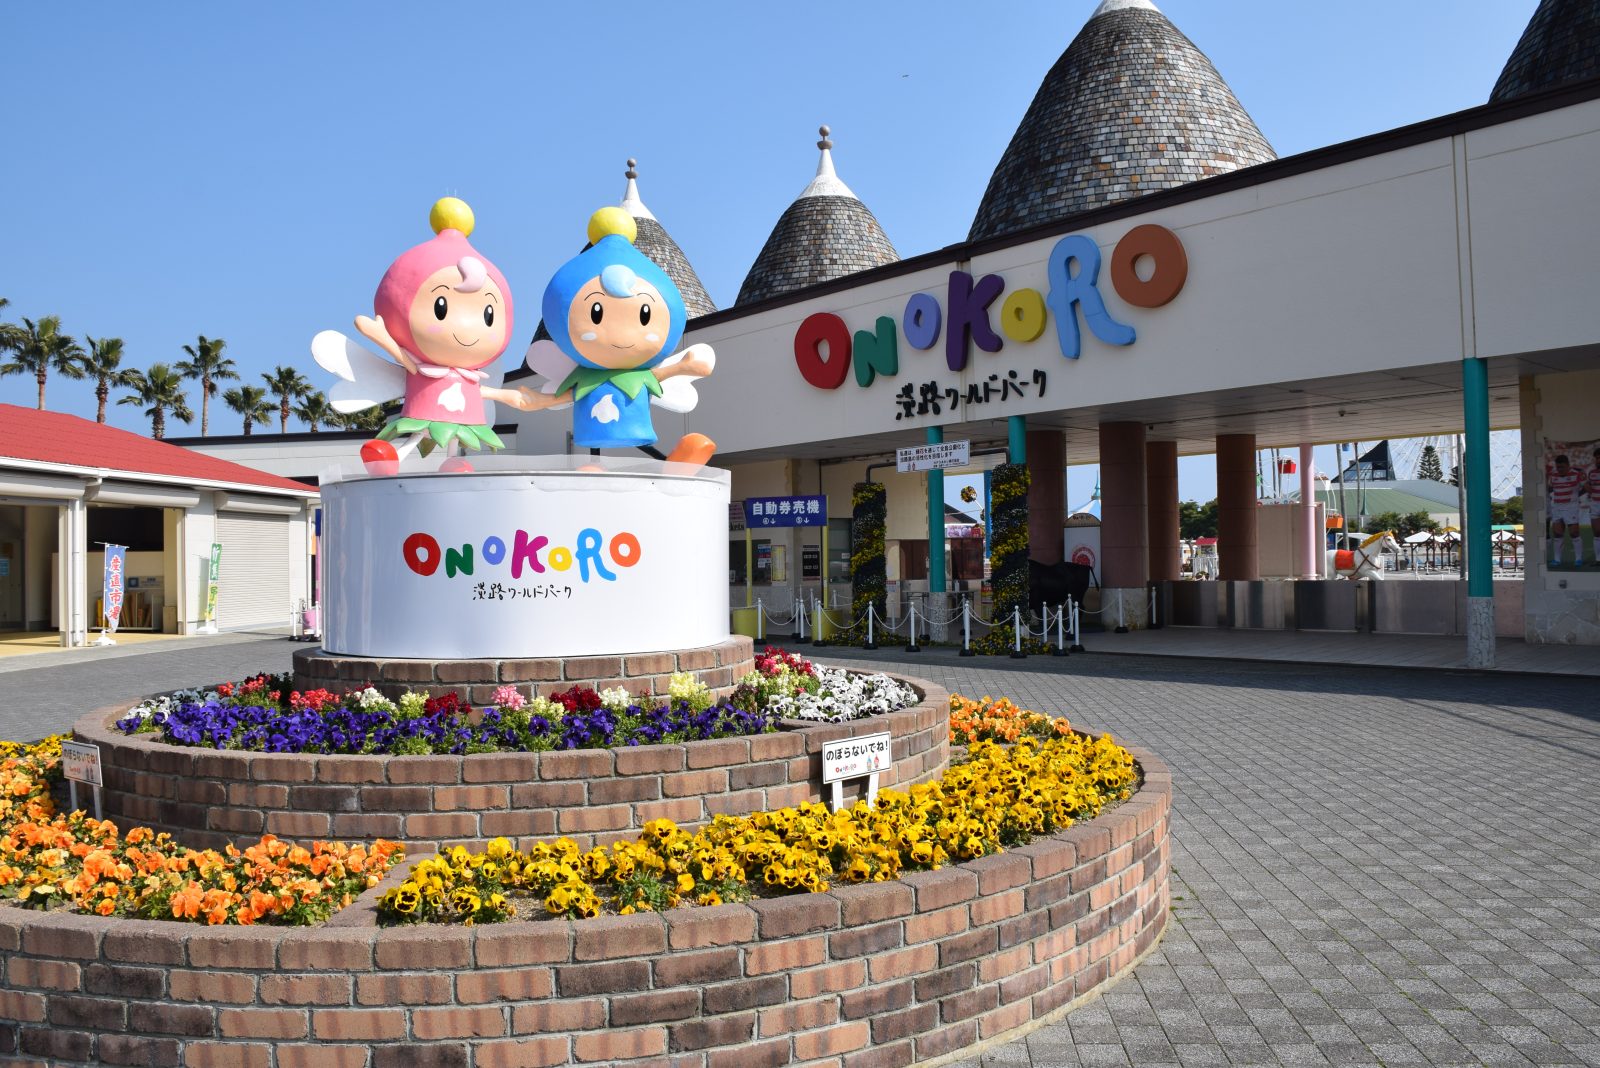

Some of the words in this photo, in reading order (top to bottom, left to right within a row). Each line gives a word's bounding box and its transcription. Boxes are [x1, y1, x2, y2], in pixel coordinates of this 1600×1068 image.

[895, 368, 1047, 421] 淡路ワールドパーク
[752, 499, 820, 516] 自動券売機
[472, 582, 572, 601] 淡路ワールドパーク
